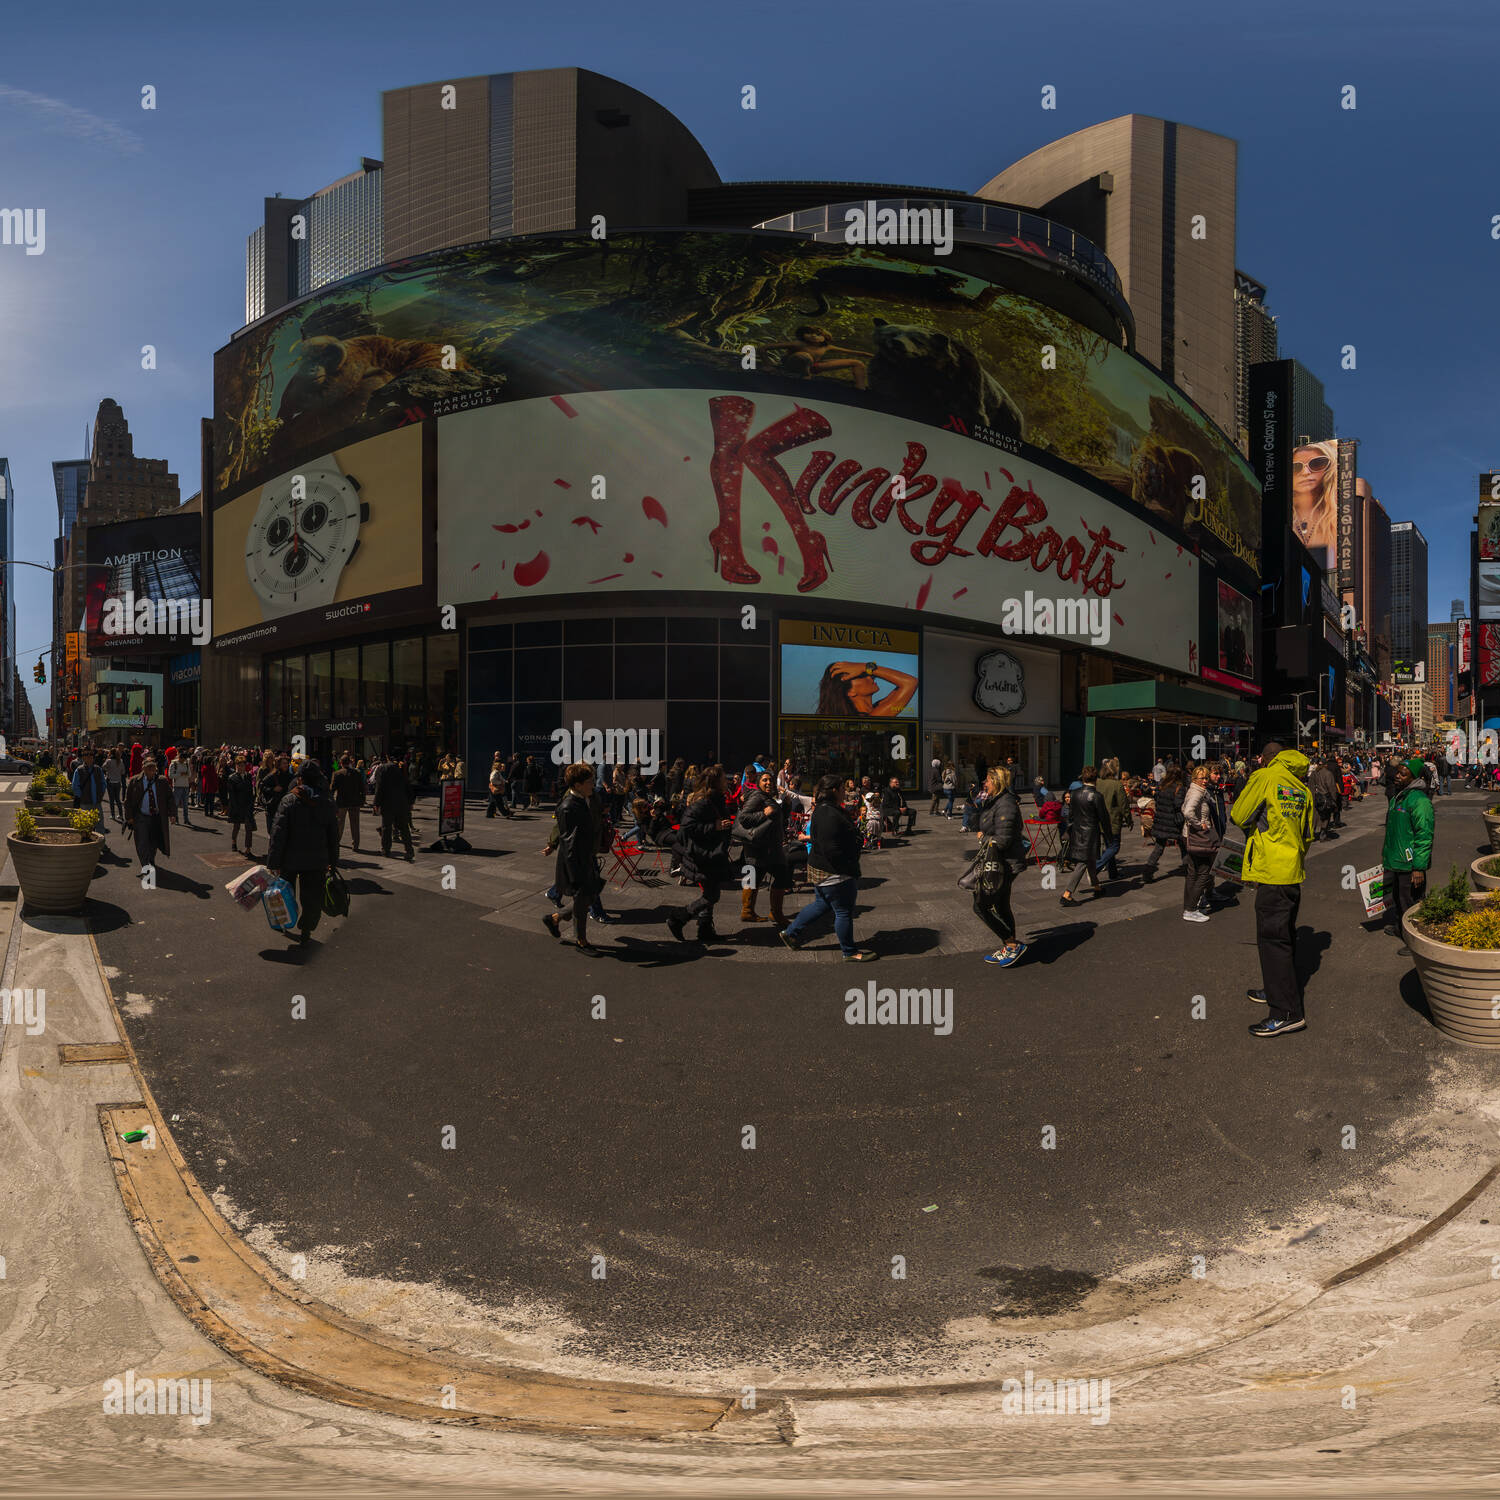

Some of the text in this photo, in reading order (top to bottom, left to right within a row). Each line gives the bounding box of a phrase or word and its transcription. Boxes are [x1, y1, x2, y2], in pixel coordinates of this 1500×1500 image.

[433, 387, 501, 407] MARRIOTT
[433, 396, 493, 414] MARQUIS
[1266, 391, 1279, 409] edge
[974, 424, 1023, 448] MARRIOTT
[974, 432, 1018, 453] MARQUIS
[1264, 420, 1278, 450] Galaxy
[1265, 453, 1275, 473] new
[1263, 474, 1275, 493] The
[708, 396, 1127, 597] Kinky Boots
[1340, 454, 1353, 570] TIMES SQUARE
[104, 548, 182, 567] AMBITION
[325, 603, 365, 620] swatch
[813, 624, 893, 647] INVICTA
[324, 721, 358, 732] swatch
